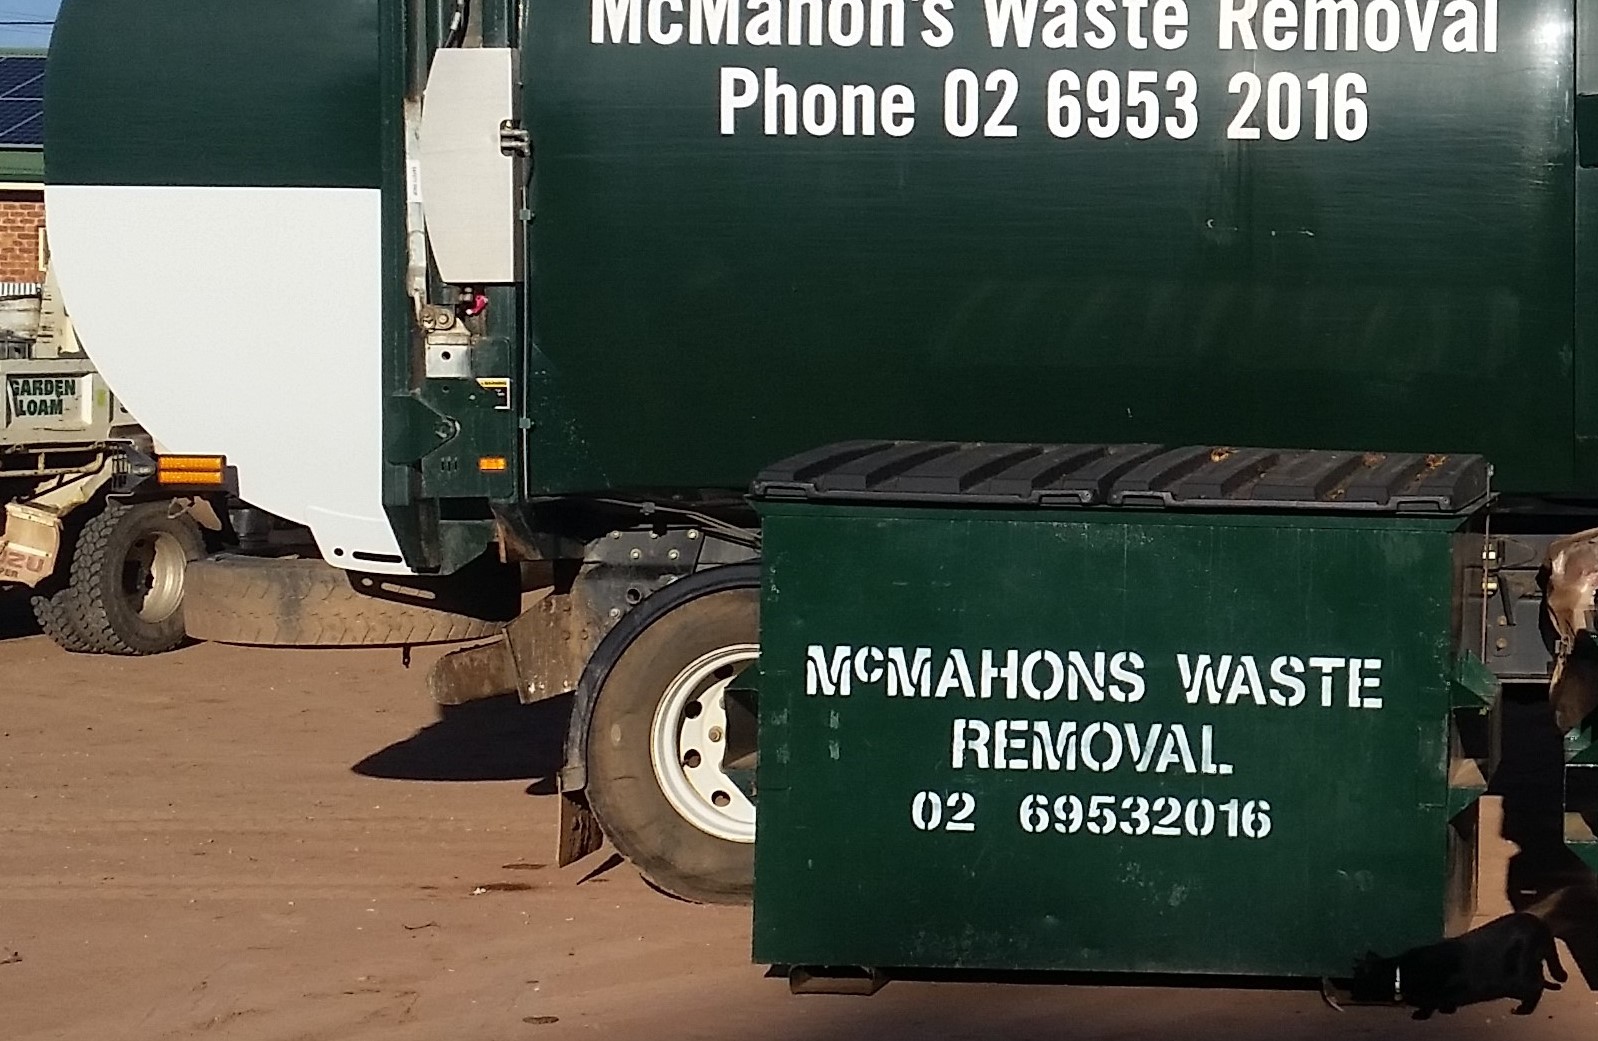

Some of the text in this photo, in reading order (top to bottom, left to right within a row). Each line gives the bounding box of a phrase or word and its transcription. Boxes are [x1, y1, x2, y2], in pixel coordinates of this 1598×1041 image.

[720, 66, 1368, 141] Phone 02 6953 2016
[11, 379, 76, 397] GARDEN
[18, 399, 63, 416] LOAM
[1176, 653, 1383, 709] WASTE
[952, 718, 1234, 775] REMOVAL
[911, 791, 1271, 839] 02 69532016
